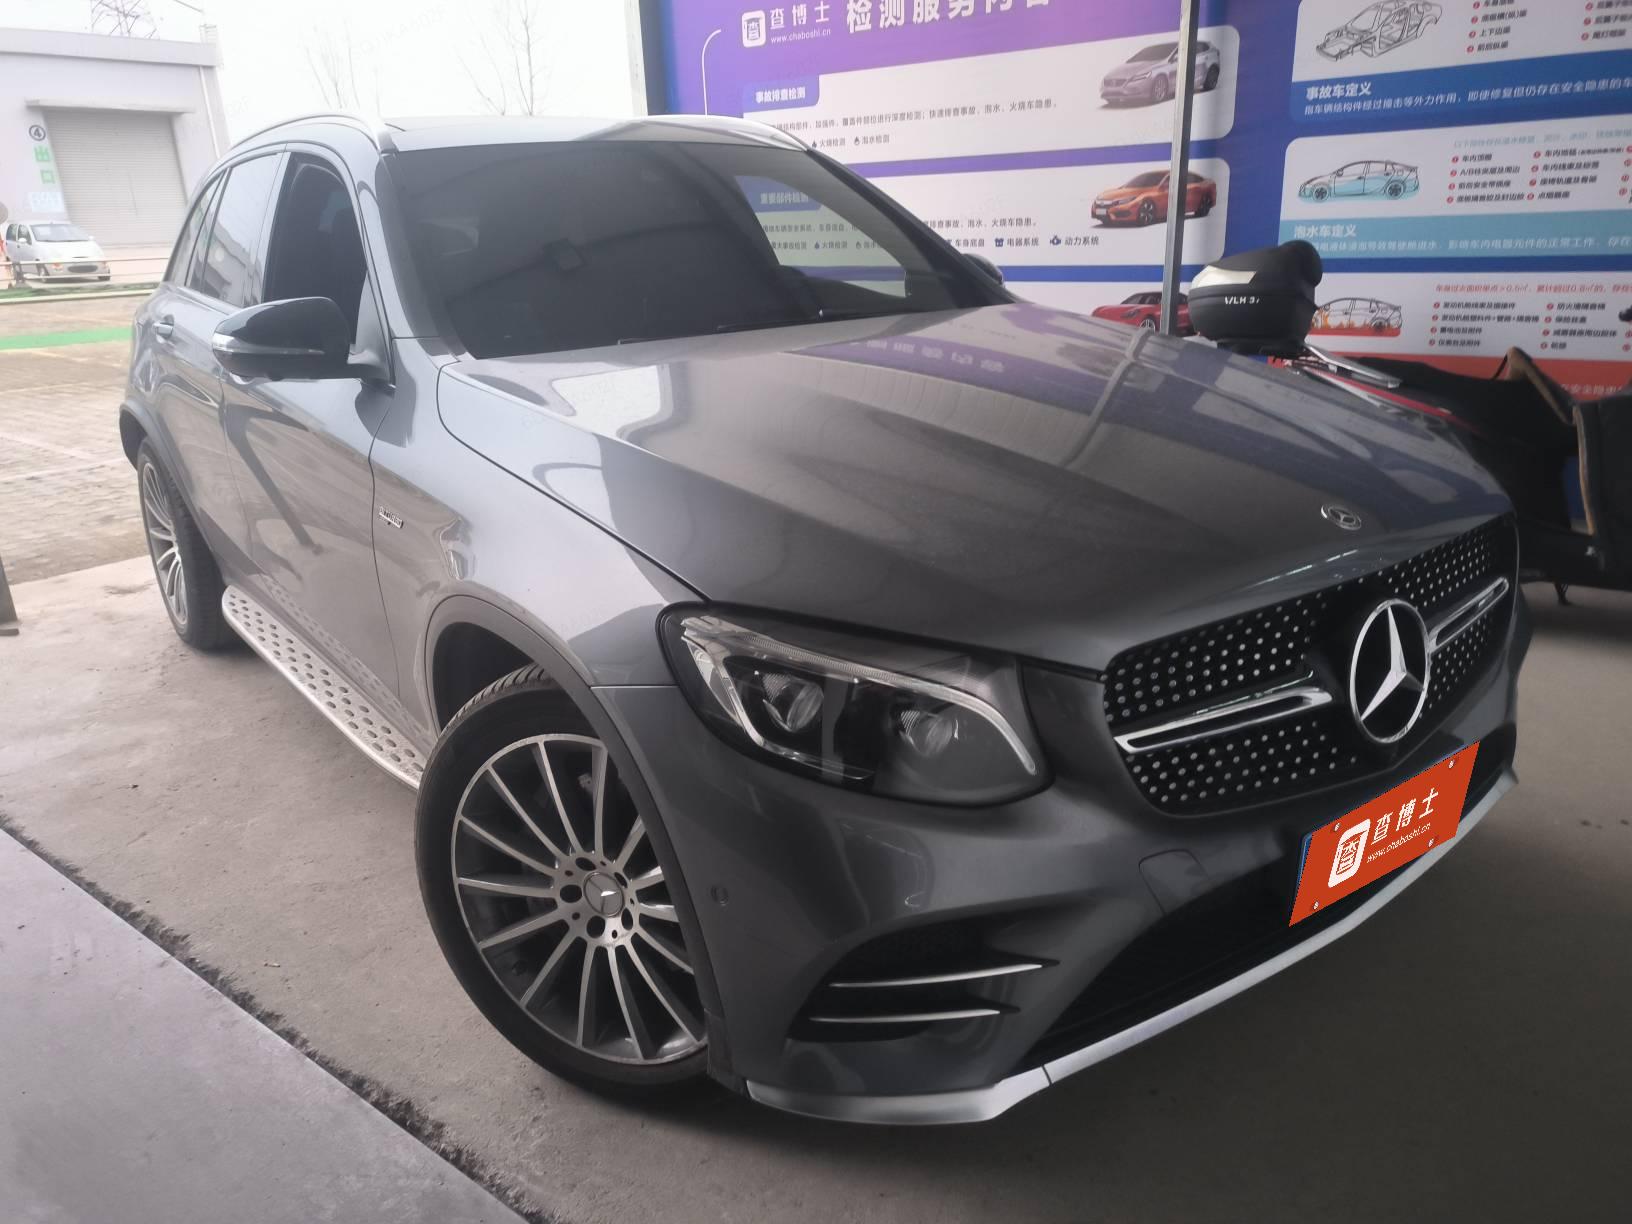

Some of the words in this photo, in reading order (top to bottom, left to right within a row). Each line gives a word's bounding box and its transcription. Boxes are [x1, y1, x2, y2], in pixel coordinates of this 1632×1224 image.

[769, 1, 831, 30] 查博士
[846, 0, 1050, 33] 检测服务
[770, 28, 832, 44] www.chaboshi.cn
[755, 86, 806, 103] 事故排查检测
[1305, 81, 1372, 101] 事故车定义
[1294, 224, 1357, 239] 泡水车定义
[1007, 236, 1040, 247] 电器系统
[1065, 235, 1100, 246] 动力系统
